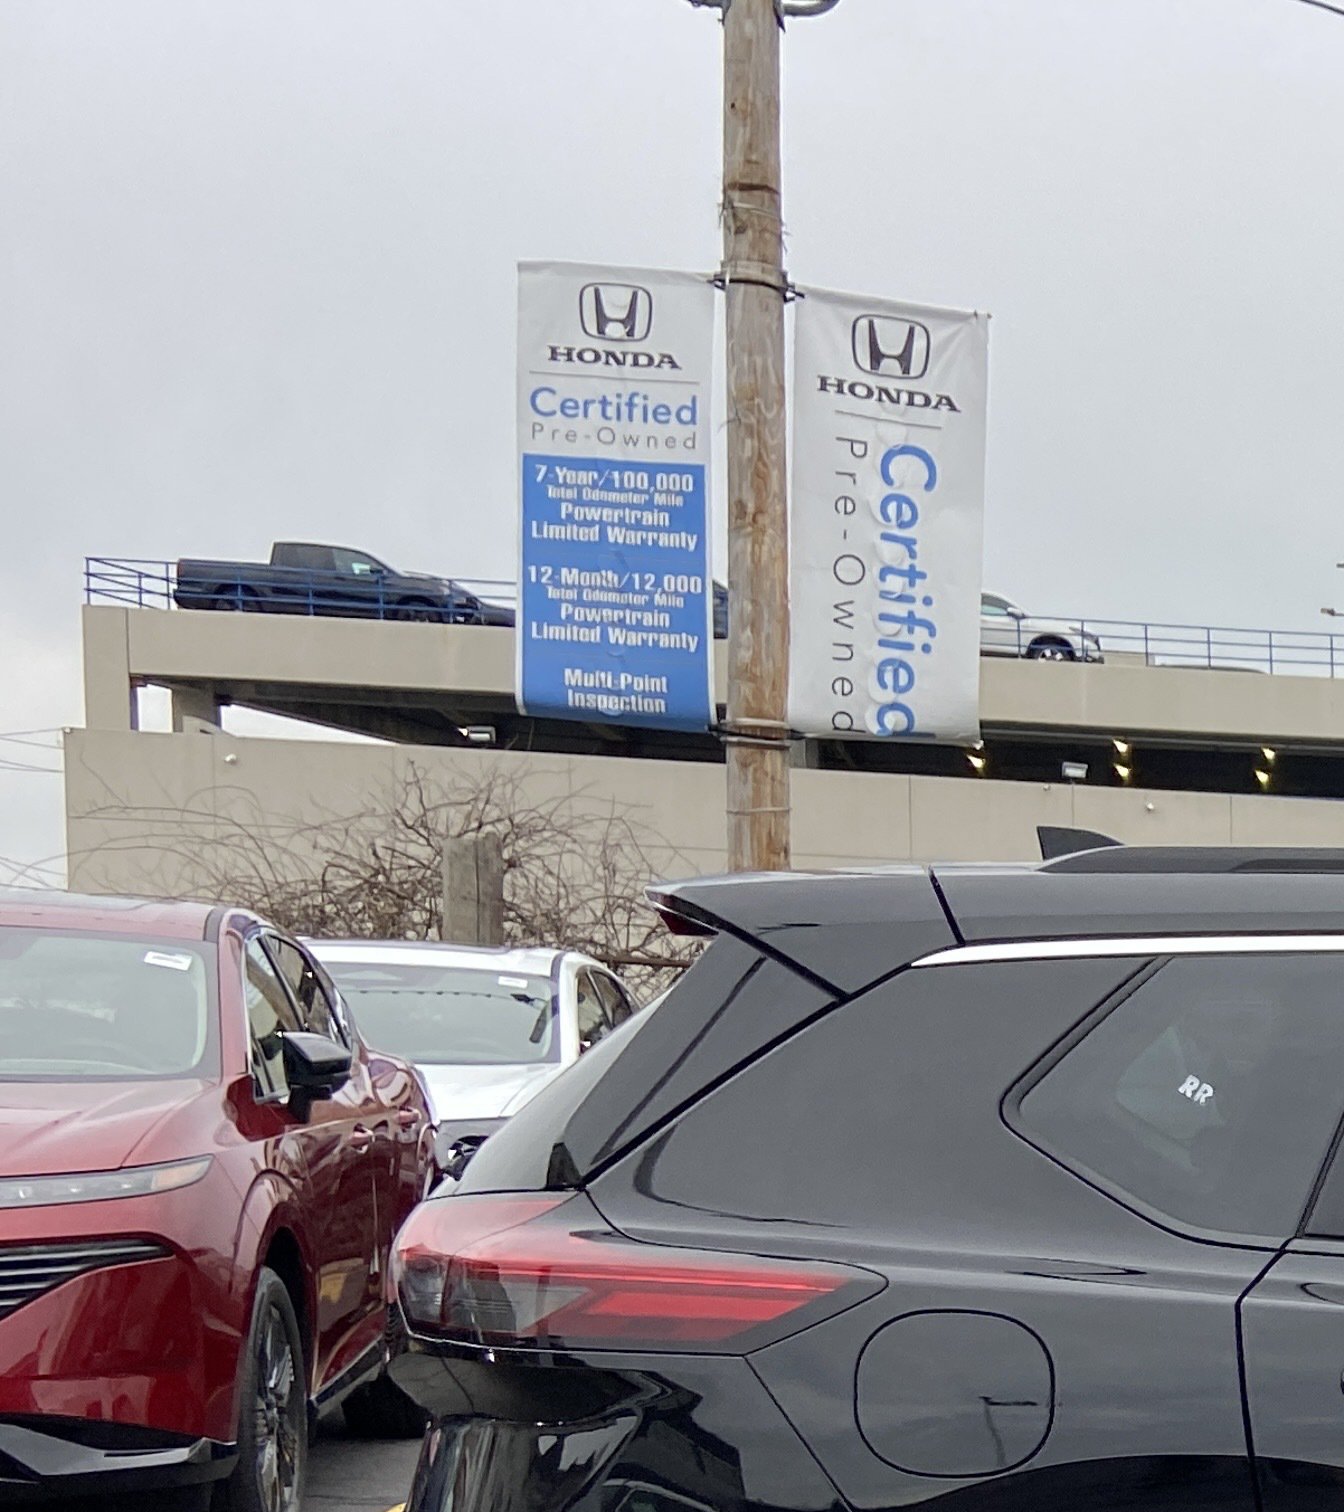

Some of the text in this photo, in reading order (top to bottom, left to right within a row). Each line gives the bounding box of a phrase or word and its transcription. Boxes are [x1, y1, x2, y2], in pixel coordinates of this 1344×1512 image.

[546, 344, 683, 370] HONDA
[531, 386, 698, 426] Certified
[817, 374, 962, 413] HONDA
[531, 421, 697, 450] Pre-Owned
[535, 463, 694, 493] 7-Year/100,000
[546, 484, 578, 500] Total
[582, 488, 650, 505] Odometer
[560, 502, 670, 528] Powertrain
[531, 520, 698, 552] Limited Warranty
[528, 565, 702, 595] 12-Month/12,000
[546, 586, 578, 600] Total
[831, 436, 868, 734] Pre-Owned
[876, 444, 937, 739] Certified
[560, 602, 671, 629] Powertrain
[531, 621, 699, 653] Limited Warranty
[564, 668, 668, 693] Multi-Point
[568, 689, 666, 714] Inspection
[1178, 1074, 1214, 1105] RR
